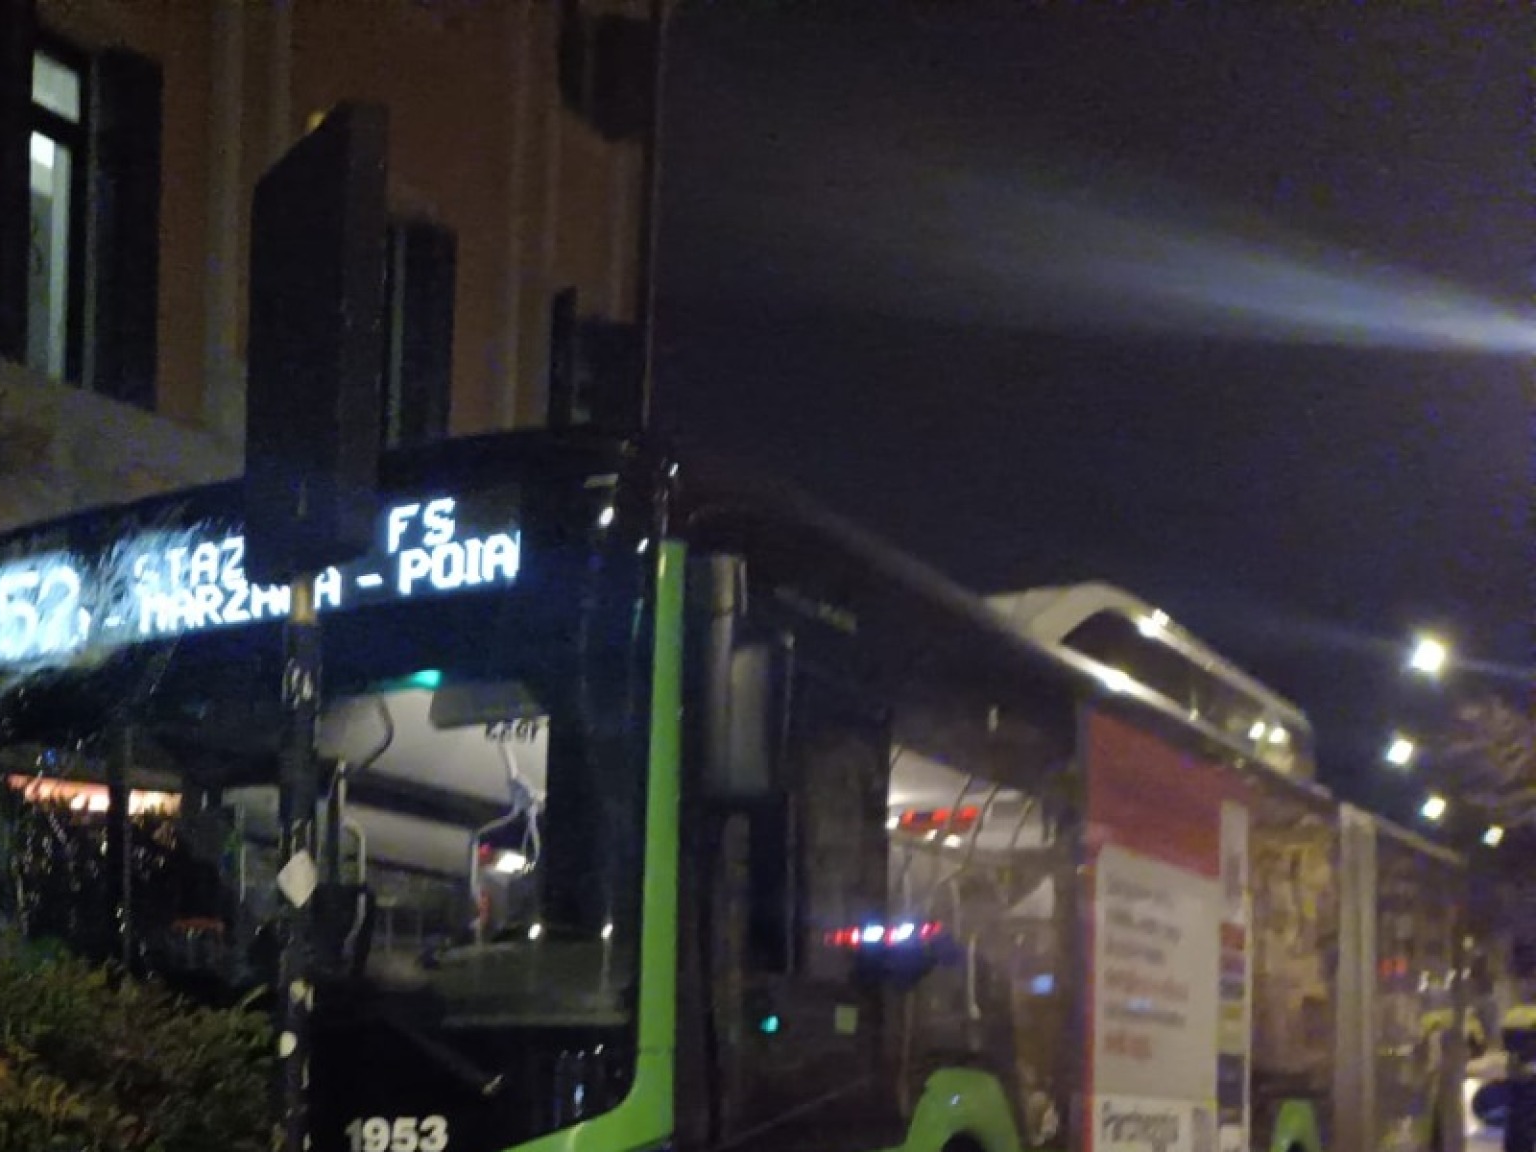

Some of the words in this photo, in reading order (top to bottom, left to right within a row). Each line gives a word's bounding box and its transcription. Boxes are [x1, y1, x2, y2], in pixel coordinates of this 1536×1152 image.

[132, 534, 246, 590] STAZ
[386, 496, 456, 553] FS
[397, 529, 521, 595] POIA
